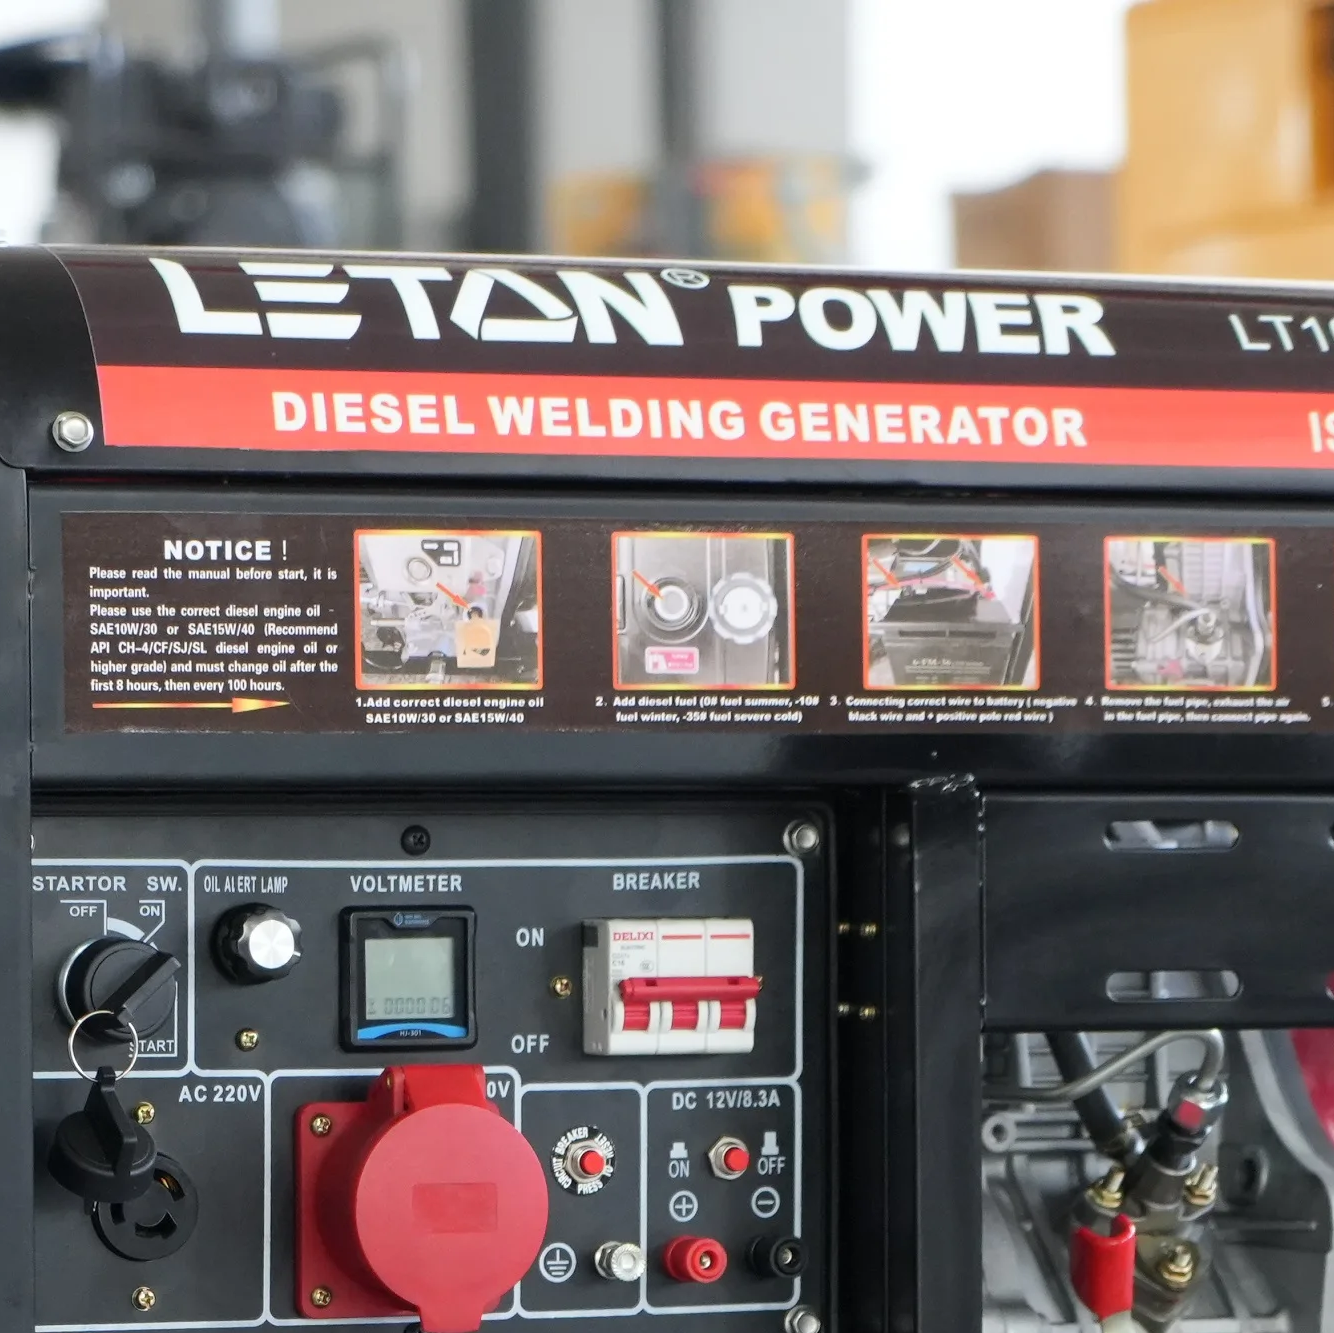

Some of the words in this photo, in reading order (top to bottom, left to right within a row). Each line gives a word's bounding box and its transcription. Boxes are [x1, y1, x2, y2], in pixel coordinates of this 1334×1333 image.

[727, 285, 1116, 356] POWER
[271, 391, 475, 434] DIESEL
[486, 396, 746, 440] WELDING
[759, 401, 1087, 447] GENERATOR
[164, 540, 271, 560] NOTICE
[89, 567, 126, 579] Please
[132, 568, 157, 579] read
[164, 568, 182, 579] the
[188, 568, 230, 579] manual
[236, 568, 272, 579] before
[278, 568, 307, 581] start,
[313, 568, 321, 579] it
[328, 568, 337, 580] is
[89, 586, 149, 600] important.
[90, 604, 126, 617] Please
[132, 607, 151, 617] use
[157, 605, 175, 617] the
[181, 605, 220, 617] correct
[225, 605, 258, 617] diesel
[264, 605, 301, 619] engine
[306, 605, 320, 617] oil
[90, 623, 157, 635] SAE10W/30
[167, 627, 179, 635] or
[188, 624, 255, 635] SAE15W/40
[264, 624, 338, 636] (Recommend
[91, 642, 110, 654] API
[216, 642, 248, 654] diesel
[257, 643, 295, 656] engine
[303, 643, 317, 654] oil
[326, 645, 338, 654] or
[91, 661, 127, 675] higher
[131, 661, 166, 675] grade)
[171, 661, 192, 673] and
[196, 662, 224, 673] must
[228, 661, 268, 675] change
[272, 661, 286, 673] oil
[290, 661, 316, 673] after
[319, 661, 338, 673] the
[91, 679, 113, 691] first
[117, 680, 123, 691] 8
[127, 679, 161, 693] hours,
[165, 680, 190, 691] then
[194, 682, 224, 693] every
[228, 680, 247, 691] 100
[250, 680, 285, 691] hours.
[356, 697, 390, 707] 1.Add
[393, 698, 440, 707] correct
[443, 697, 481, 707] diesel
[484, 697, 525, 710] engine
[529, 697, 543, 707] oil
[613, 696, 635, 706] Add
[639, 696, 672, 706] diesel
[675, 696, 698, 706] fuel
[720, 696, 742, 707] fuel
[745, 697, 792, 708] summer,
[846, 696, 905, 708] Connecting
[908, 696, 946, 707] correct
[948, 696, 971, 707] wire
[974, 696, 984, 707] to
[987, 696, 1024, 708] battery
[1033, 697, 1077, 708] negative
[366, 713, 436, 724] SAE10W/30
[455, 713, 524, 724] SAE15W/40
[616, 712, 637, 722] fuel
[641, 712, 679, 723] winter,
[710, 712, 731, 722] fuel
[734, 714, 771, 722] severe
[774, 712, 802, 723] cold)
[849, 711, 877, 722] black
[880, 712, 902, 722] wire
[905, 712, 925, 722] and
[936, 712, 977, 723] positive
[979, 712, 1002, 723] pole
[1004, 712, 1021, 722] red
[1024, 712, 1046, 722] wire
[32, 876, 127, 891] STARTOR
[147, 876, 182, 891] SW.
[204, 876, 220, 892] OIL
[261, 876, 288, 893] LAMP
[350, 875, 462, 892] VOLTMETER
[613, 872, 700, 890] BREAKER
[69, 906, 97, 917] OFF
[140, 905, 160, 916] ON
[516, 928, 544, 947] ON
[613, 932, 654, 940] DELIXI
[511, 1034, 549, 1053] OFF
[179, 1086, 207, 1102] AC
[213, 1084, 261, 1102] 220V
[672, 1091, 697, 1110] DC
[707, 1089, 781, 1109] 12V/8.3A
[554, 1126, 589, 1155] BREAKER
[552, 1157, 572, 1189] CIRCUIT
[669, 1160, 690, 1178] ON
[757, 1157, 786, 1175] OFF
[577, 1180, 604, 1195] PRESS
